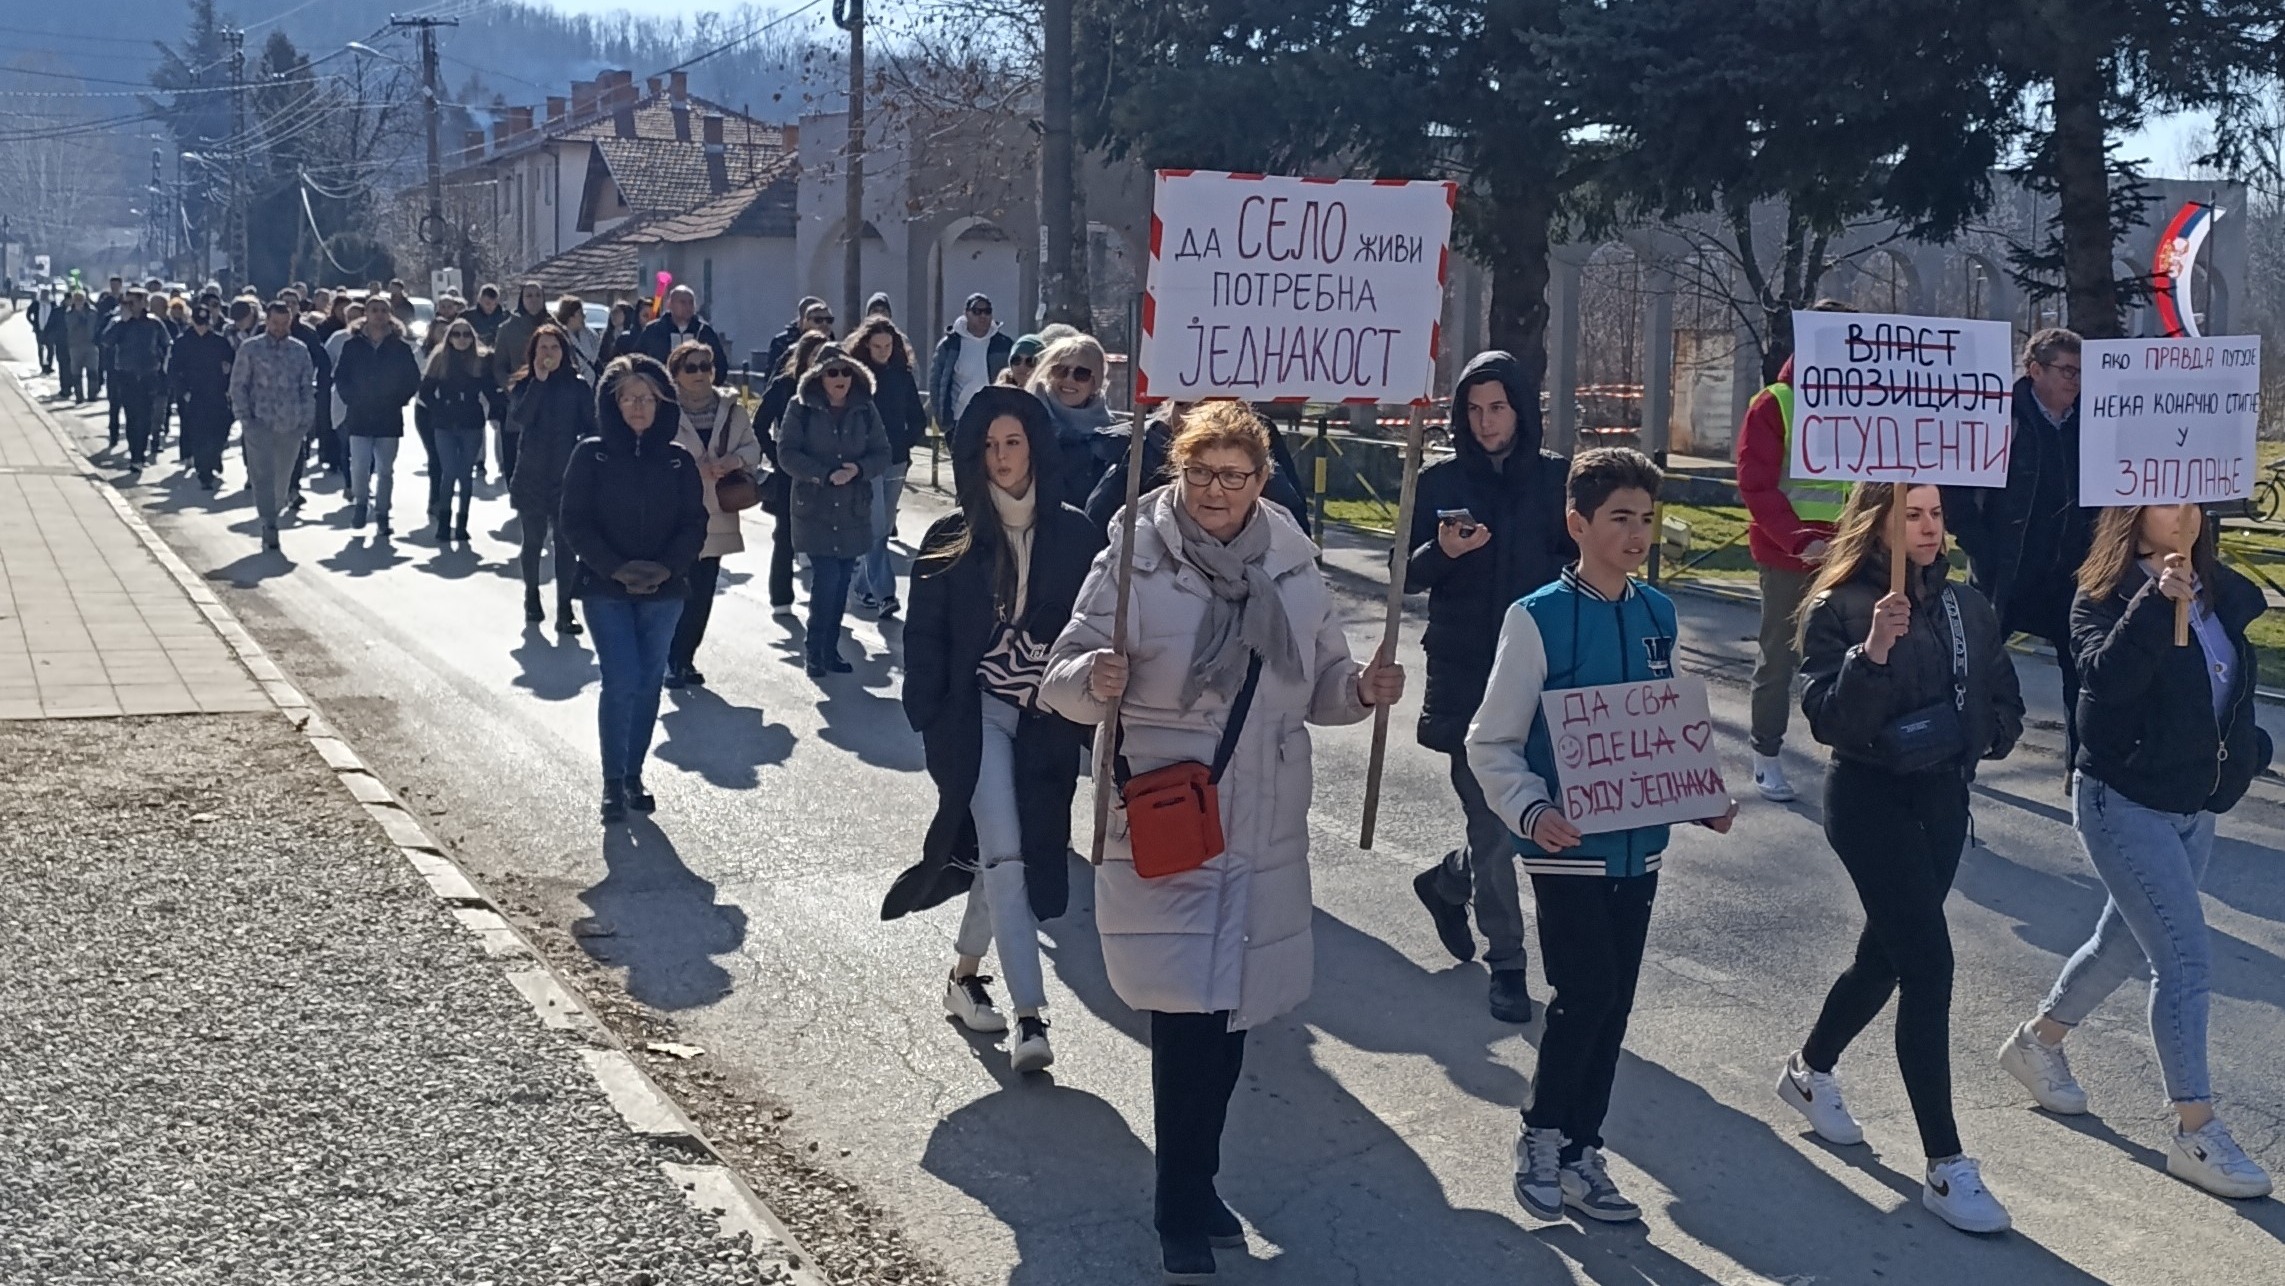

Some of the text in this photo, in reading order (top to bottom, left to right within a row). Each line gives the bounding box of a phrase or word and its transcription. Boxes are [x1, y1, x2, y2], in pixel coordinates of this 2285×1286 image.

[1175, 195, 1423, 264] ДА СЕЛО ЖИВИ
[1213, 271, 1377, 312] ПОТРЕБНА
[1179, 316, 1401, 388] ЈЕДНАКОСТ
[1848, 323, 1961, 367] ВЛАСТ
[2101, 353, 2131, 370] АКО
[2145, 346, 2215, 371] ПРАВДА
[1803, 365, 2004, 414] ОПОЗИЦИЈА
[2093, 394, 2144, 418] НЕКА
[2153, 392, 2218, 415] КОНАЧНО
[1802, 414, 2009, 477] СТУДЕНТИ
[2176, 426, 2189, 447] У
[2115, 457, 2243, 499] ЗАПЛАЊЕ
[1562, 683, 1680, 730] ДА СВА
[1587, 725, 1676, 768] ДЕЦА
[1566, 766, 1728, 820] БУДУ ЈЕДНАКА
